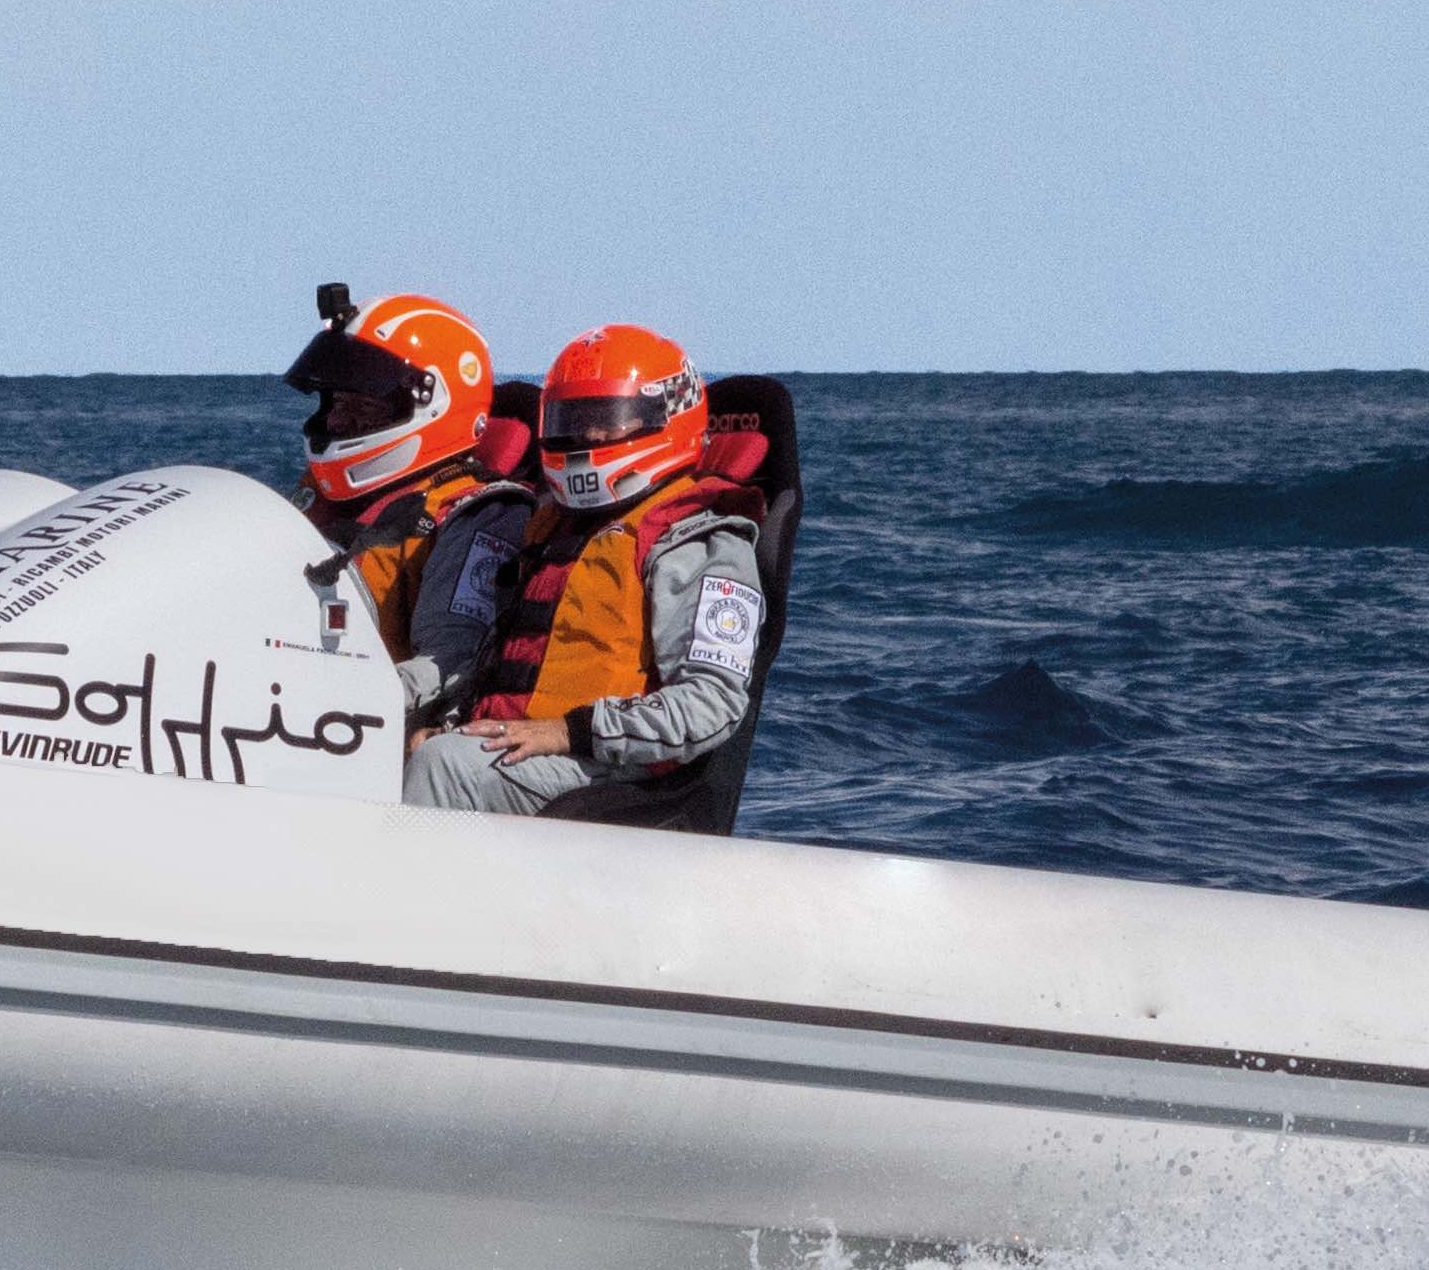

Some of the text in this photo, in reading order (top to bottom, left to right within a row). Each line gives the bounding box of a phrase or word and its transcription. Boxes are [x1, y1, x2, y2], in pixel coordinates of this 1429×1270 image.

[708, 412, 759, 433] parco
[566, 472, 599, 495] 109
[15, 544, 81, 588] RICAMBI
[75, 512, 138, 555] MOTORI
[132, 488, 192, 523] MARINI
[64, 550, 107, 580] ITALY
